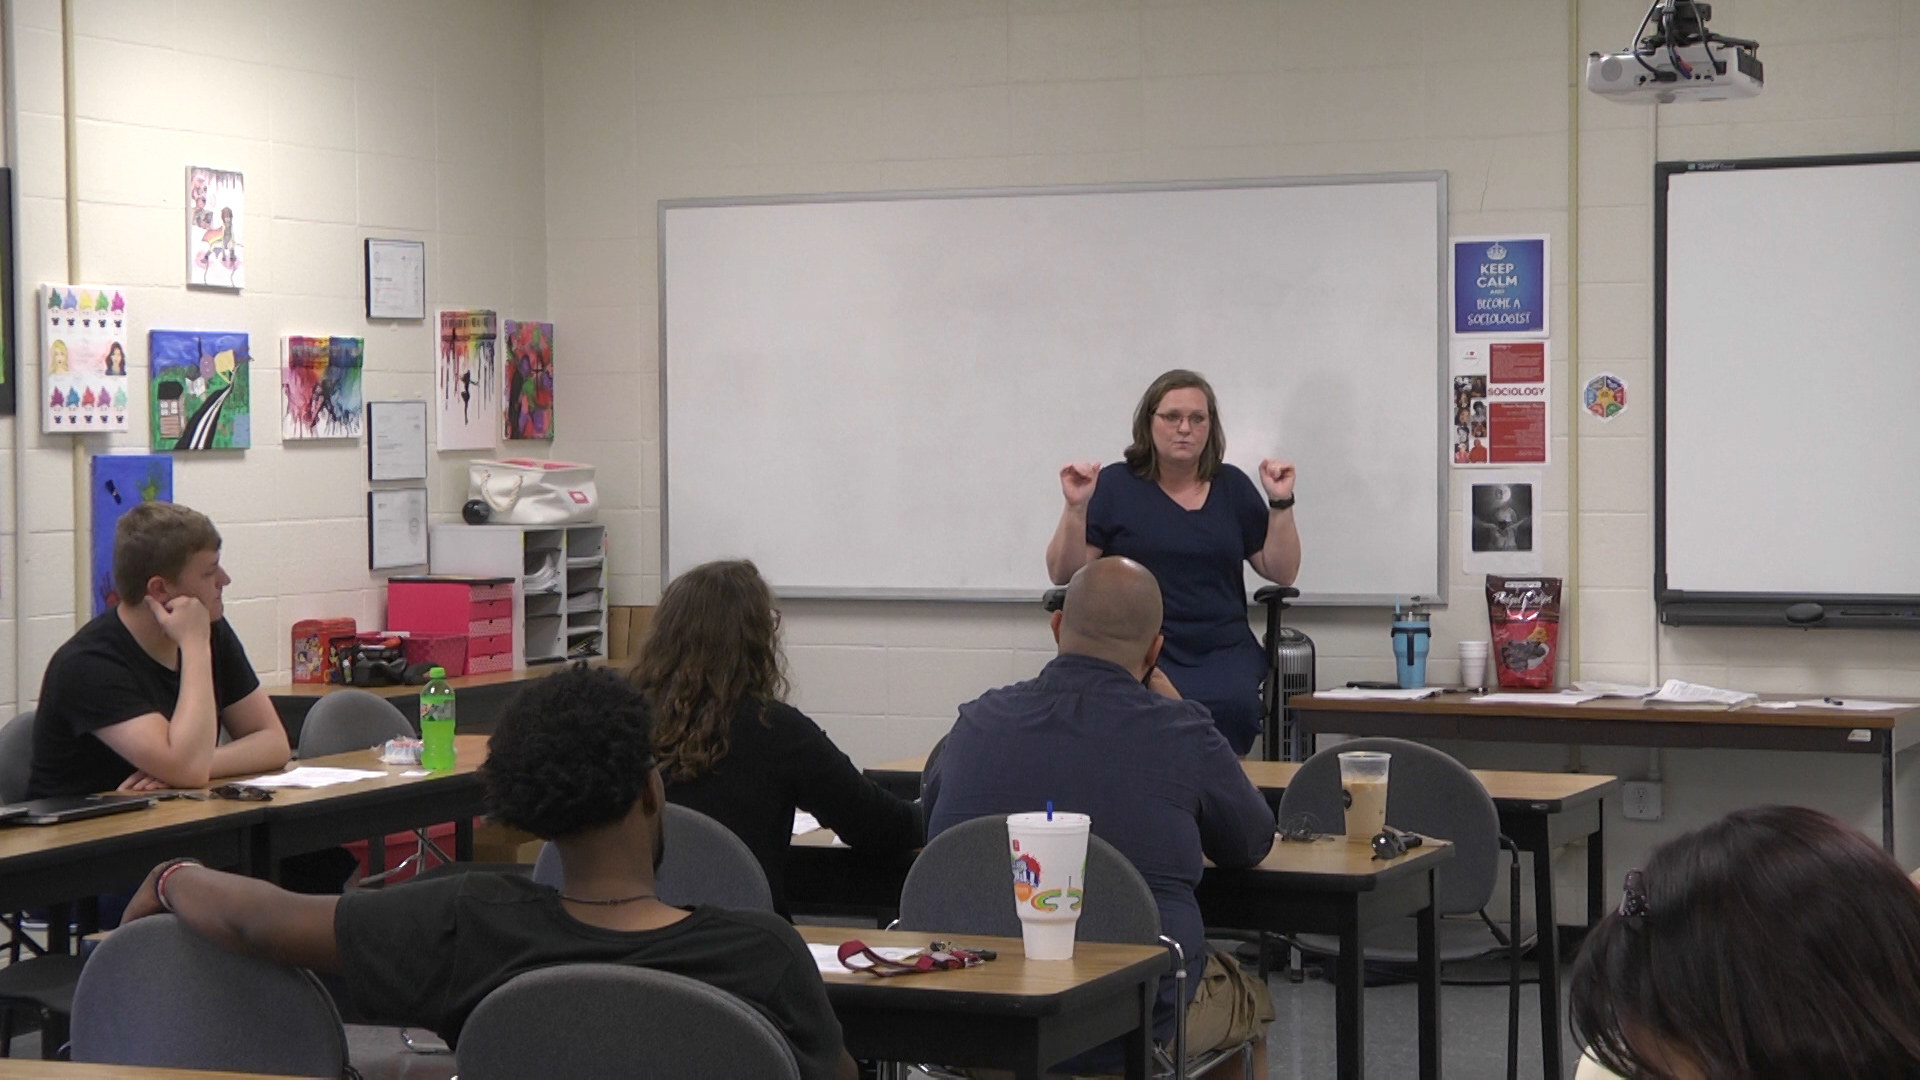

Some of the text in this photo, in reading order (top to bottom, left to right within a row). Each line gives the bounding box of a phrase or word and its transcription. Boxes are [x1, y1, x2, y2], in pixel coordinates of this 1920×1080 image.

[1480, 263, 1513, 275] KEEP
[1477, 275, 1517, 287] CALM
[1477, 297, 1520, 309] BECOME A
[1468, 312, 1530, 325] SOCIOLOGIST
[1488, 387, 1545, 396] SOCIOLOGY
